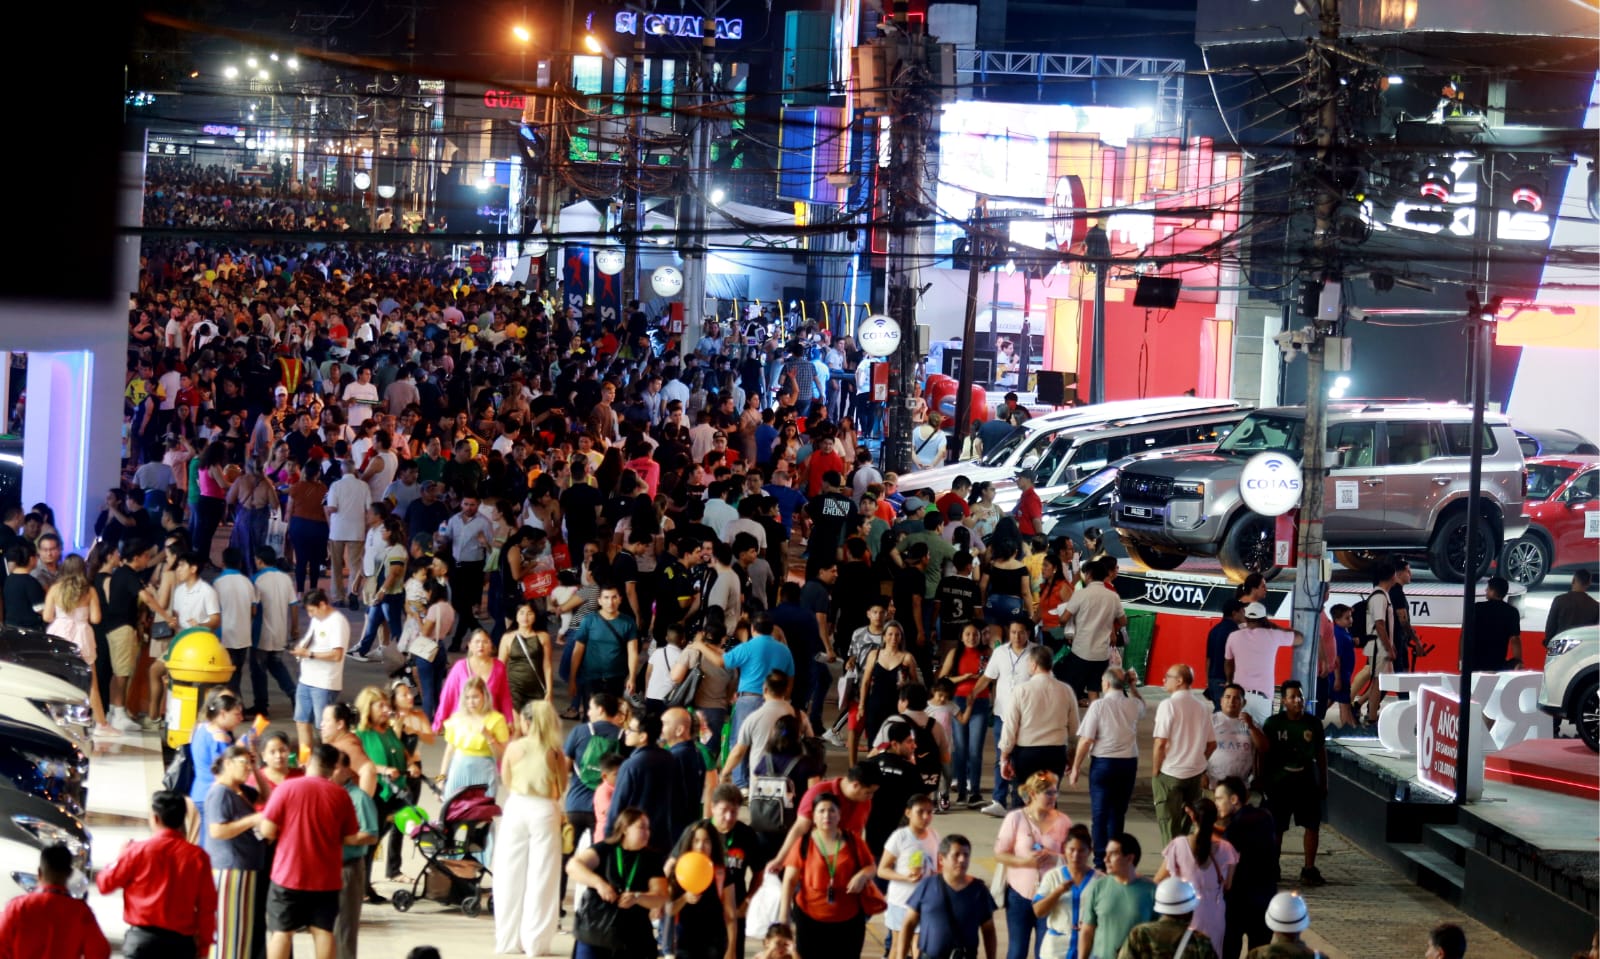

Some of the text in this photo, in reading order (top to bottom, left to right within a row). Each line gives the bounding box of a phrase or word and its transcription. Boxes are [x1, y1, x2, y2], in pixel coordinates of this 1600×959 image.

[862, 331, 900, 340] COTAS
[1246, 479, 1299, 490] COTAS
[1145, 583, 1204, 604] TOYOTA
[952, 598, 963, 618] 3
[1277, 730, 1288, 741] 14
[1422, 700, 1436, 769] 6
